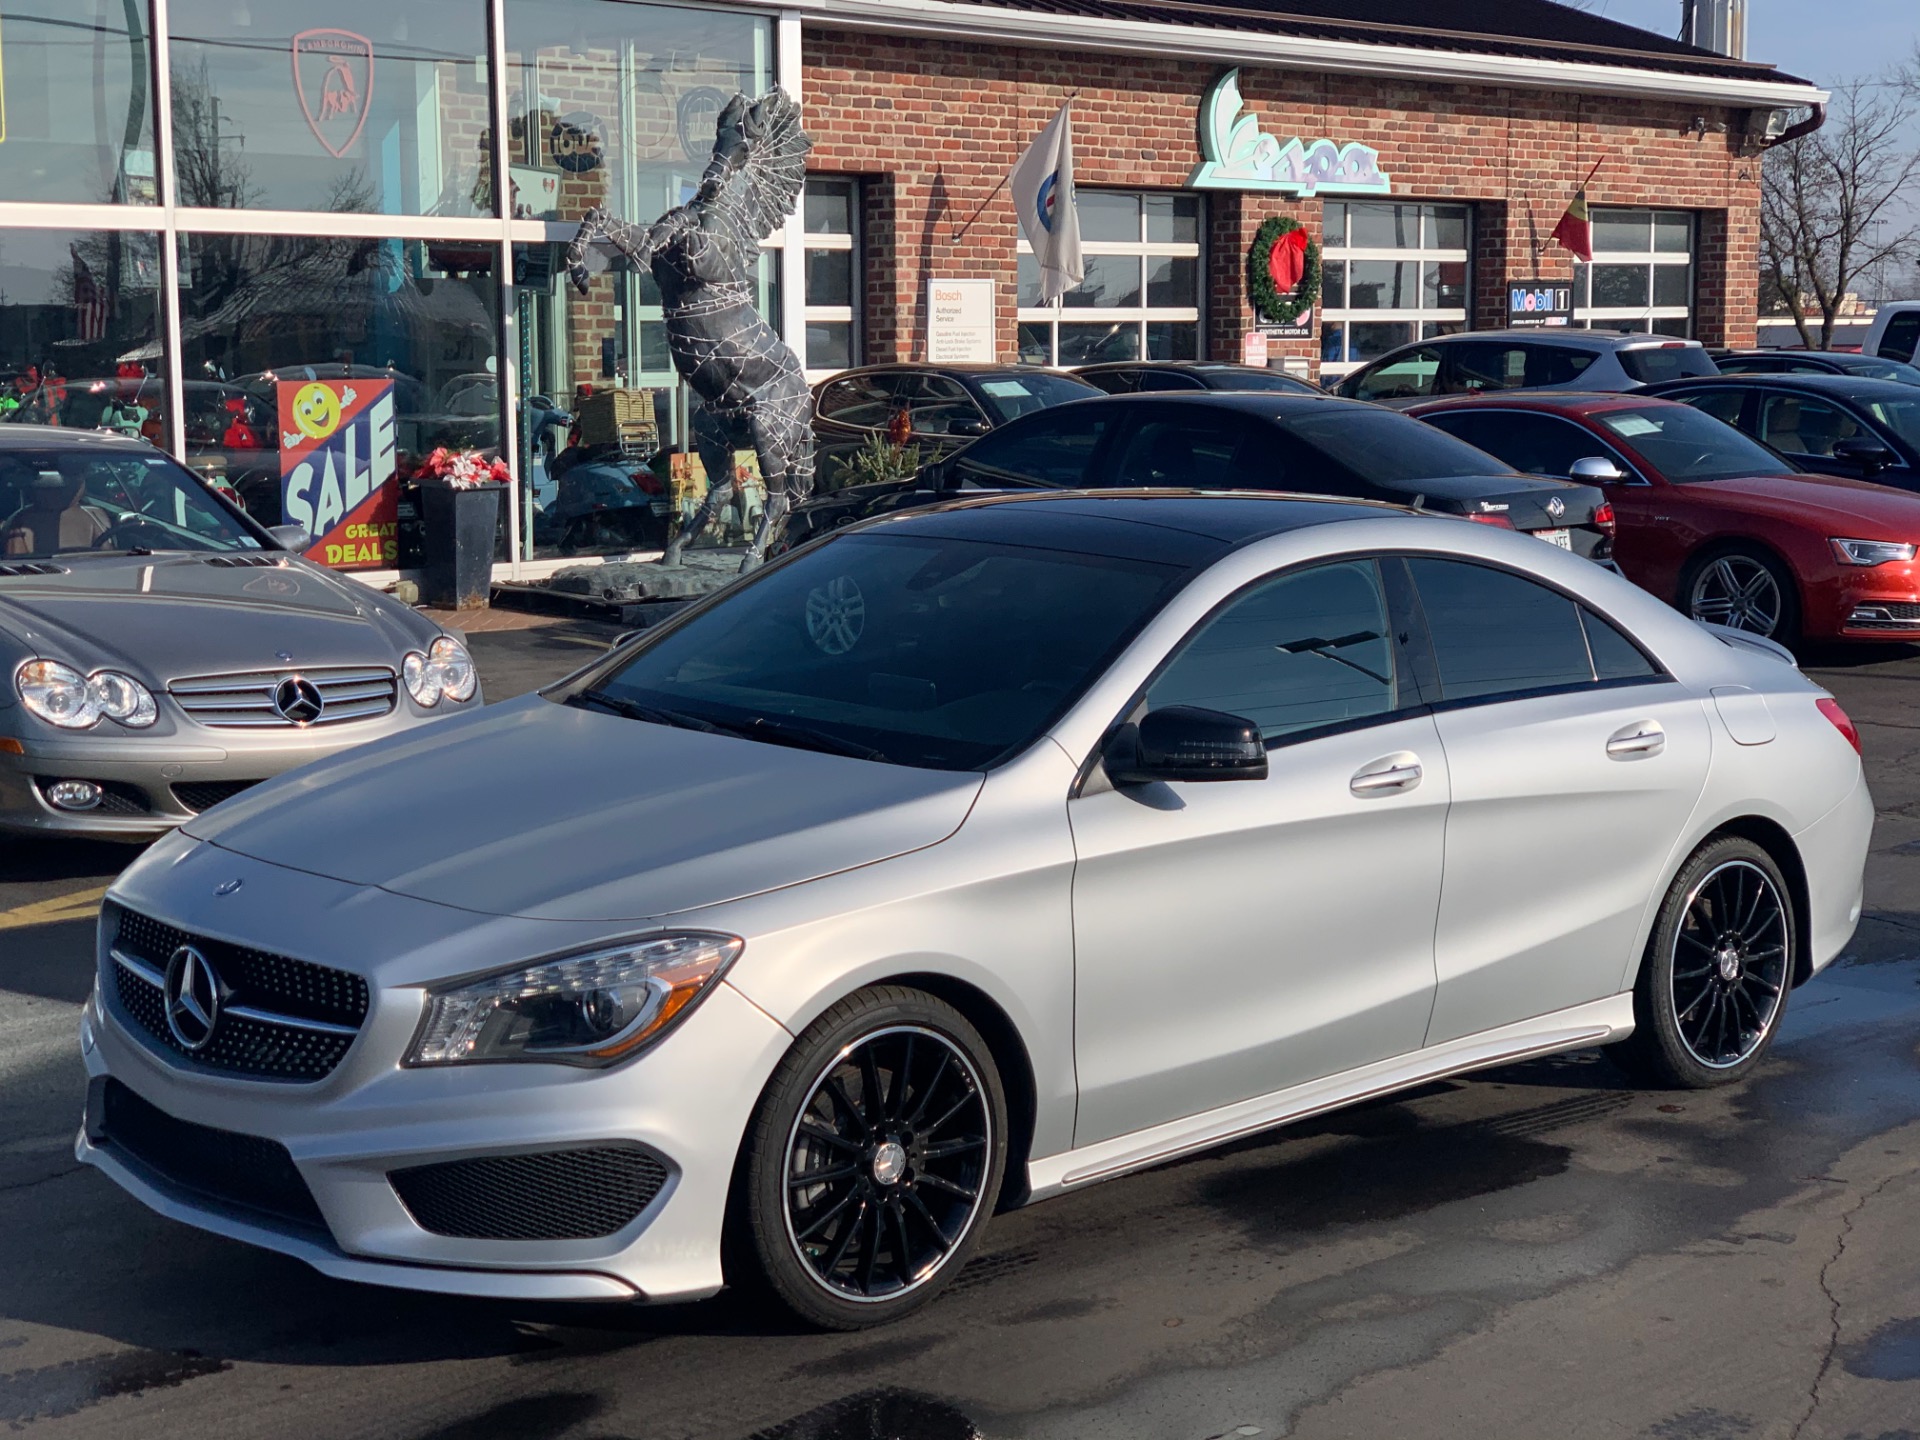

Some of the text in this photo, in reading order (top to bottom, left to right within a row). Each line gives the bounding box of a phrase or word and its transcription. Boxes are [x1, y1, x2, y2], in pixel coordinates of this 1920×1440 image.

[301, 39, 367, 56] LAMBORGHINI
[935, 289, 962, 301] Bosch
[1512, 288, 1554, 312] Mobil
[286, 391, 396, 537] SALE
[345, 522, 397, 539] GREAT
[325, 540, 398, 564] DEALS
